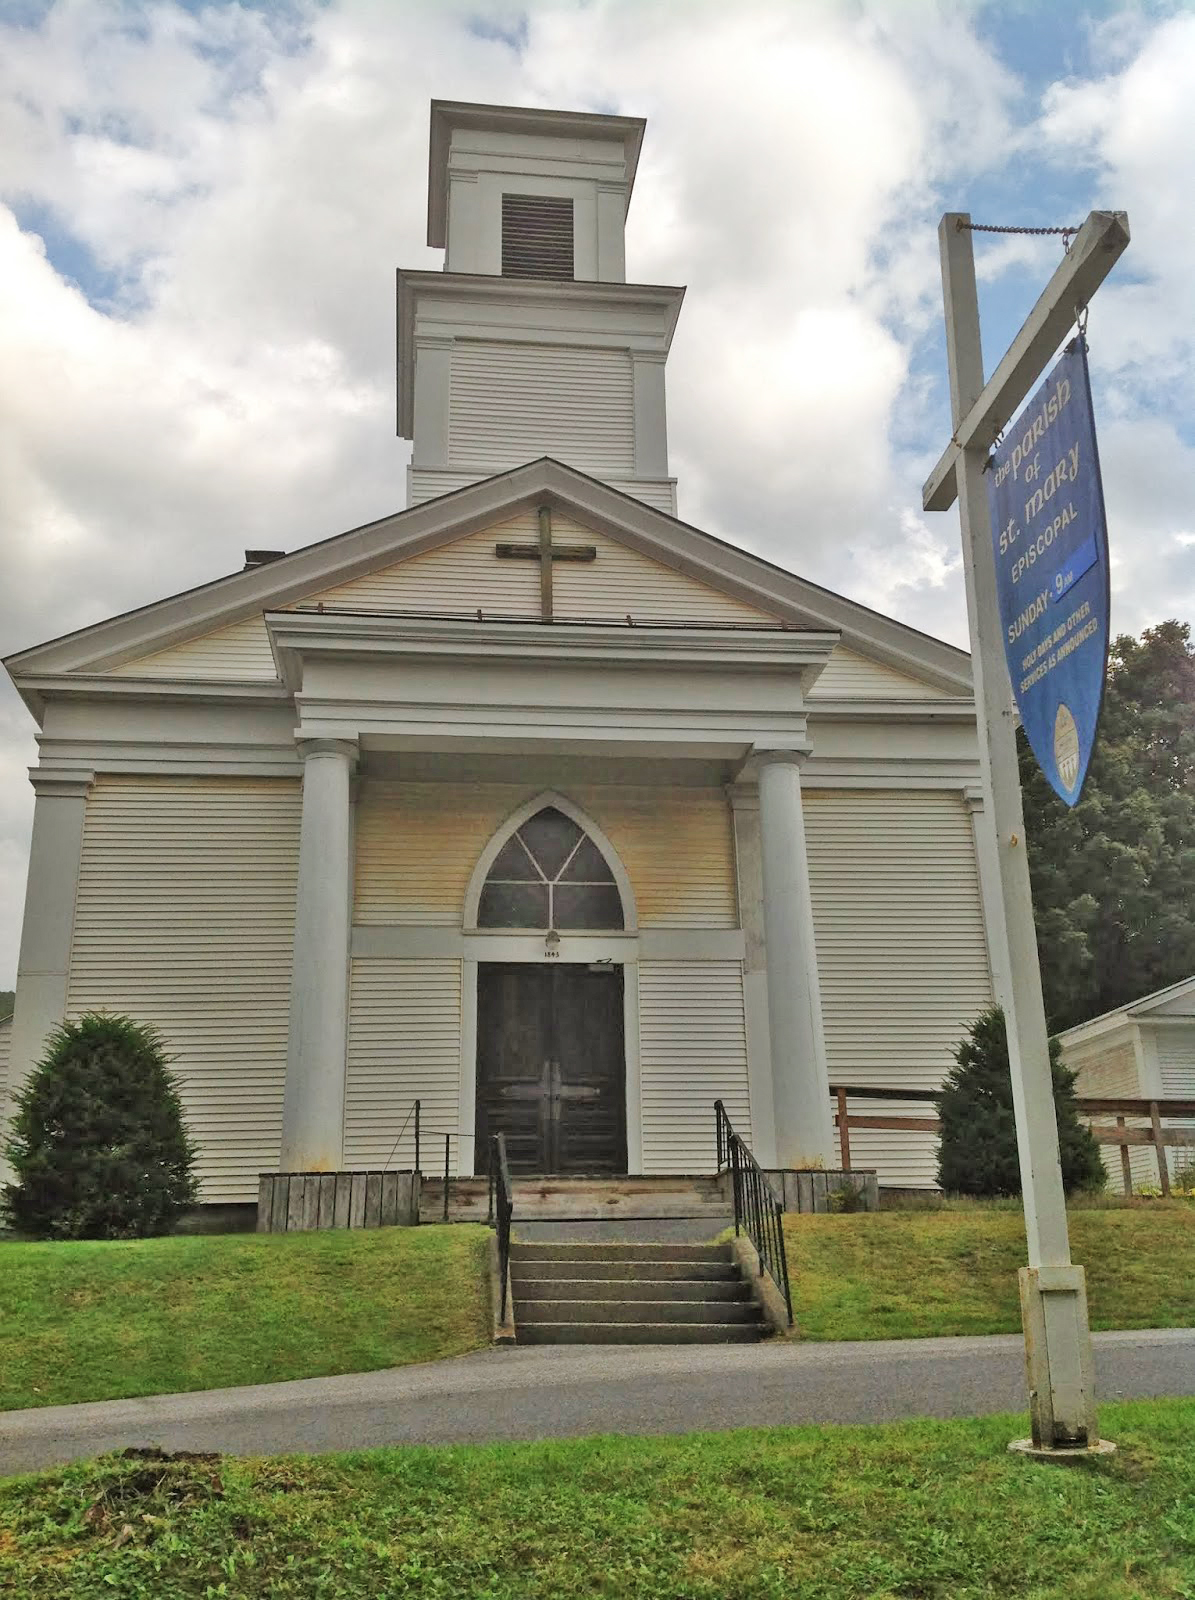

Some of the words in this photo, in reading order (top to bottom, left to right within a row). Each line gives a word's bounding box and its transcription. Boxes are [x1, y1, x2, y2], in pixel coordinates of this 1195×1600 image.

[994, 460, 1011, 488] the
[1012, 378, 1072, 481] parish
[1025, 452, 1041, 483] of
[1024, 441, 1079, 525] mary
[1011, 501, 1078, 584] EPISCOPAL
[1020, 660, 1048, 694] SERVICES
[1048, 653, 1057, 670] AS
[1057, 617, 1098, 662] ANNOUNCED
[1022, 649, 1037, 672] HOLY
[1037, 635, 1053, 657] DAYS
[1053, 623, 1067, 645] AND
[1067, 601, 1091, 631] OTHER
